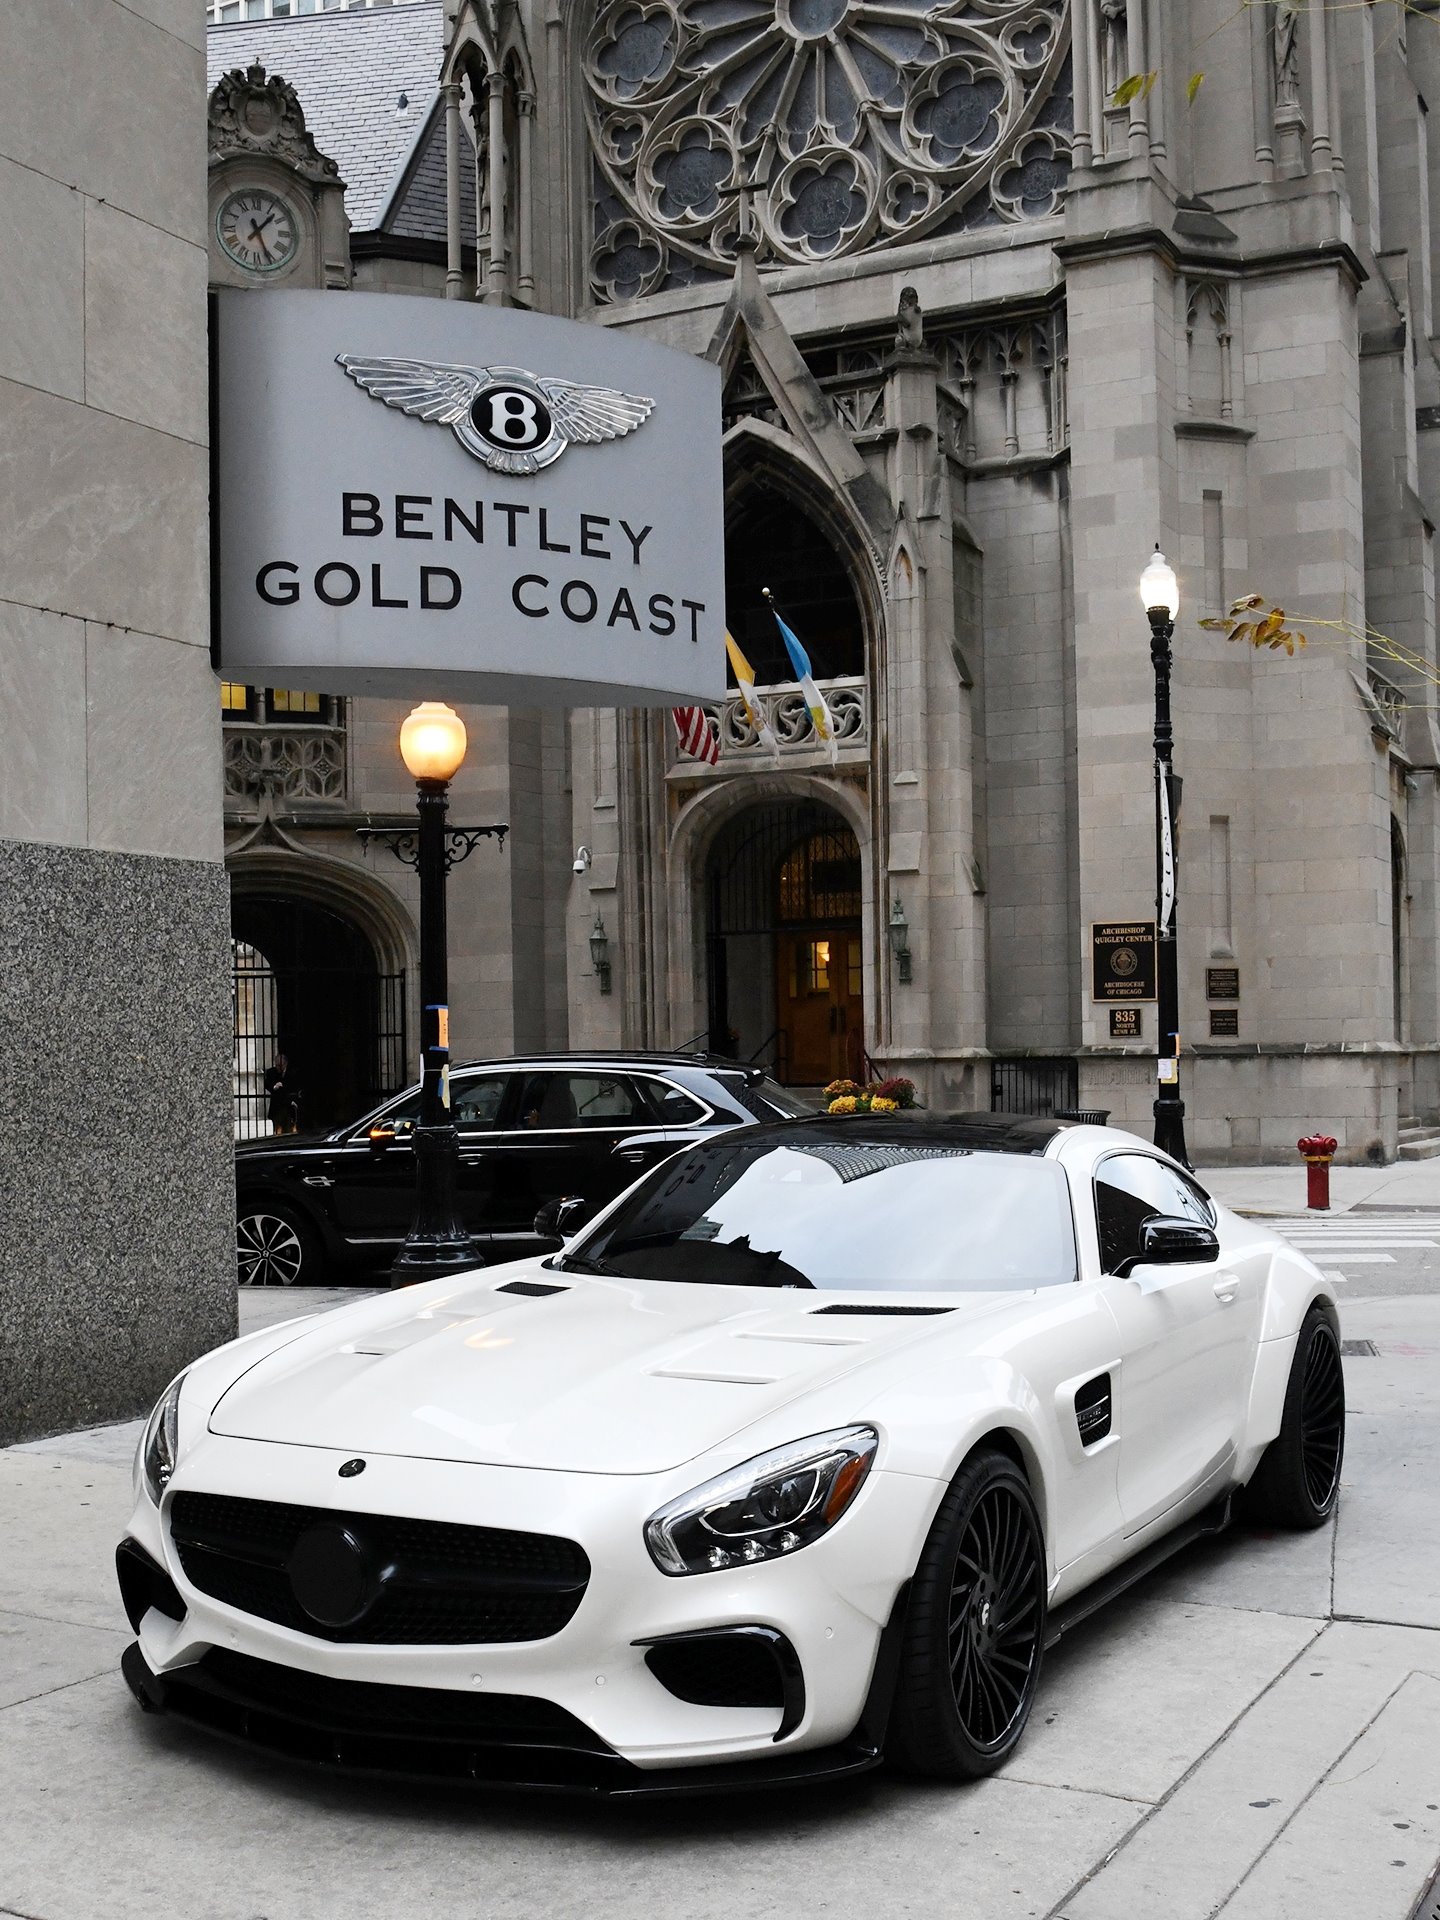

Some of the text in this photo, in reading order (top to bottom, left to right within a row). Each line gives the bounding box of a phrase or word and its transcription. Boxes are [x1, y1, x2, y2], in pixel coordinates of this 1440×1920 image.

[489, 392, 537, 443] B
[342, 492, 653, 565] BENTLEY
[255, 560, 706, 643] GOLD COAST
[1094, 935, 1153, 944] QUIGLEY CENTER
[1101, 926, 1146, 935] ARCHBISHOP
[1115, 1010, 1136, 1023] 835
